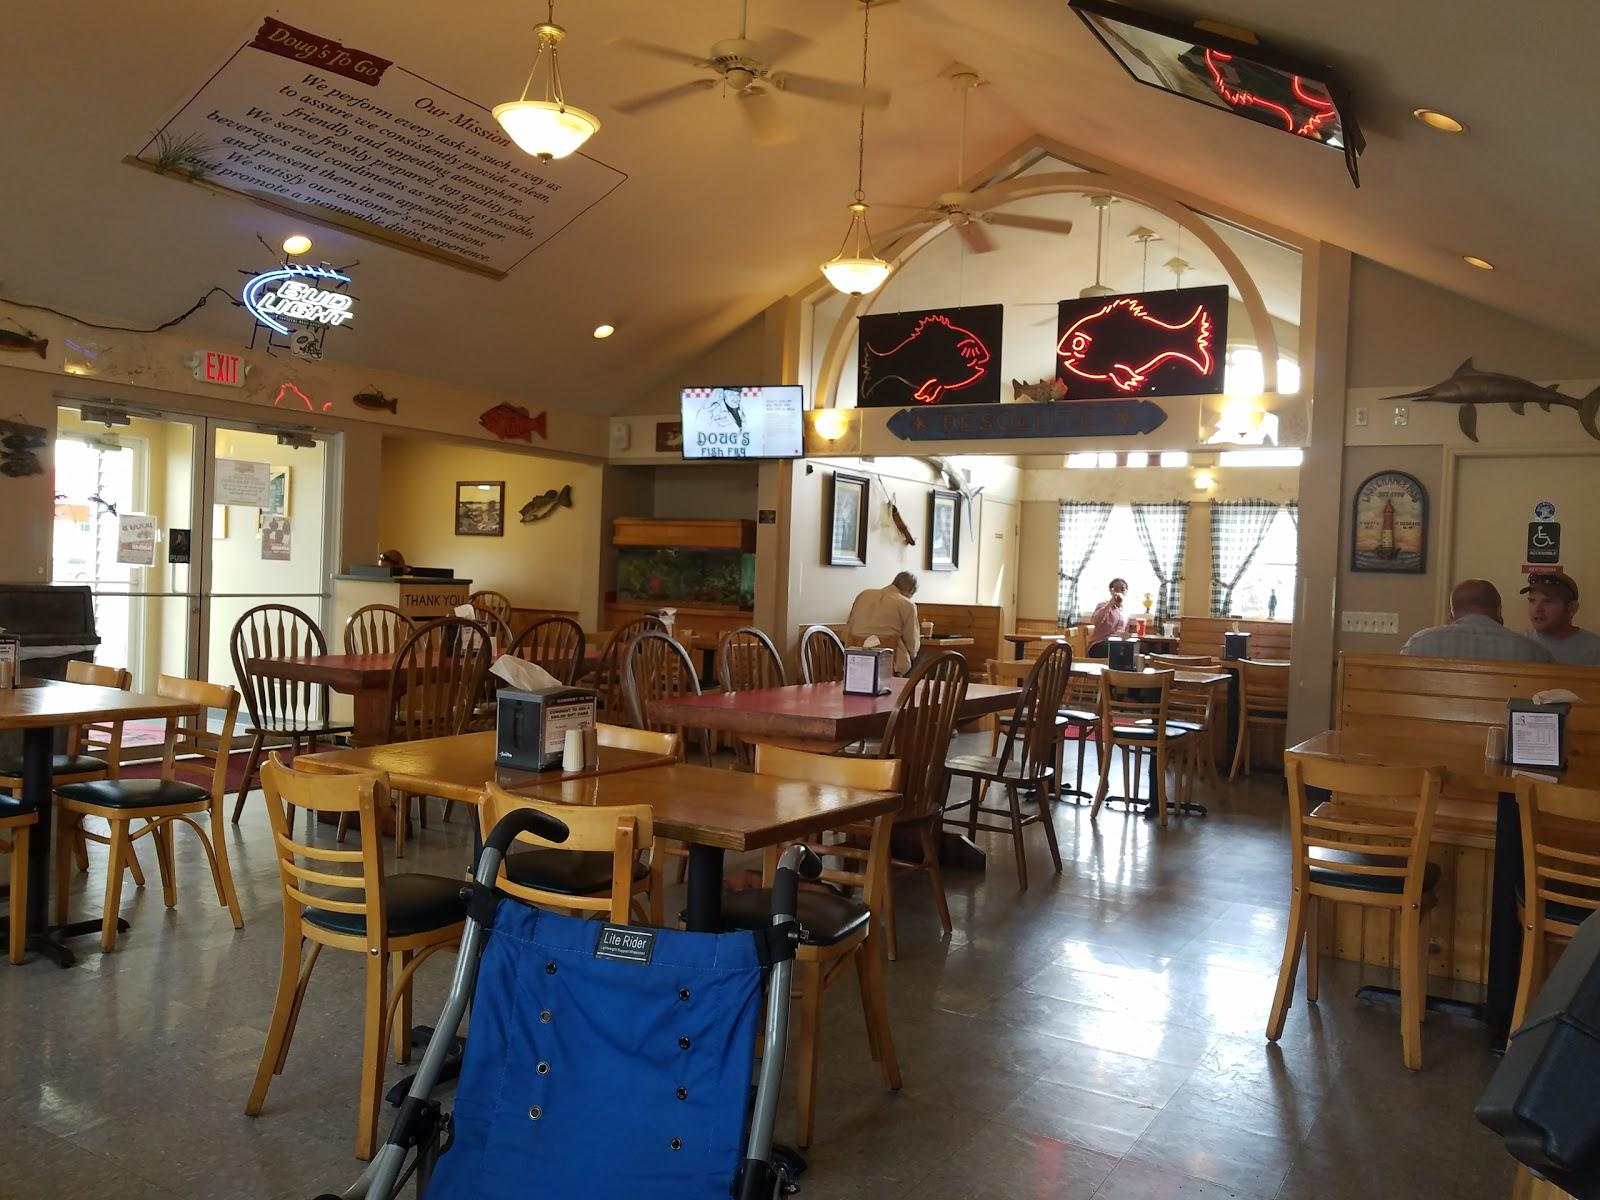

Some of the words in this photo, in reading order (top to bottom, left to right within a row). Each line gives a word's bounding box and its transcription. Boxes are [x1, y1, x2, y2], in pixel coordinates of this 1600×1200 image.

[267, 28, 331, 59] Doug's
[326, 50, 352, 67] To
[354, 60, 378, 77] Go
[246, 106, 272, 123] We
[274, 119, 318, 141] serve
[312, 137, 372, 162] freshly
[370, 158, 435, 188] prepared,
[440, 183, 462, 198] top
[462, 194, 504, 217] quality
[502, 208, 536, 225] food,
[279, 86, 297, 97] to
[300, 95, 353, 120] assure
[355, 117, 378, 130] we
[379, 128, 461, 166] consistently
[458, 161, 510, 184] provide
[509, 181, 519, 189] a
[518, 184, 550, 203] clean,
[282, 108, 352, 136] friendly
[354, 132, 386, 150] and
[384, 146, 450, 178] appealing
[451, 174, 522, 206] atmosphere.
[302, 73, 328, 91] We
[324, 88, 392, 120] perform
[394, 117, 434, 138] every
[435, 134, 465, 150] task
[466, 145, 481, 158] in
[481, 155, 510, 174] such
[521, 171, 549, 187] way
[548, 182, 561, 192] as
[414, 97, 450, 118] Our
[449, 112, 511, 147] Mission
[184, 155, 222, 171] and
[216, 167, 290, 194] promote
[303, 196, 384, 226] memorable
[385, 221, 426, 242] dining
[426, 237, 491, 261] experience.
[206, 110, 290, 148] beverages
[292, 143, 326, 159] and
[325, 153, 408, 191] condiments
[409, 188, 425, 197] as
[425, 192, 472, 217] rapidly
[471, 211, 486, 220] as
[486, 216, 534, 239] possible,
[222, 135, 256, 151] and
[254, 149, 318, 173] present
[319, 168, 357, 189] them
[358, 184, 374, 195] in
[376, 190, 395, 200] an
[396, 199, 459, 225] appealing
[458, 220, 505, 241] manner.
[226, 151, 252, 166] We
[254, 162, 306, 185] satisfy
[308, 181, 337, 194] our
[336, 192, 410, 222] customer's
[412, 219, 486, 247] expectations
[256, 292, 353, 326] LIGHT
[277, 281, 352, 312] BUD
[207, 352, 239, 384] EXIT
[405, 594, 440, 606] THANK
[442, 592, 464, 605] YOU
[604, 932, 620, 946] Lite
[622, 935, 647, 949] Rider
